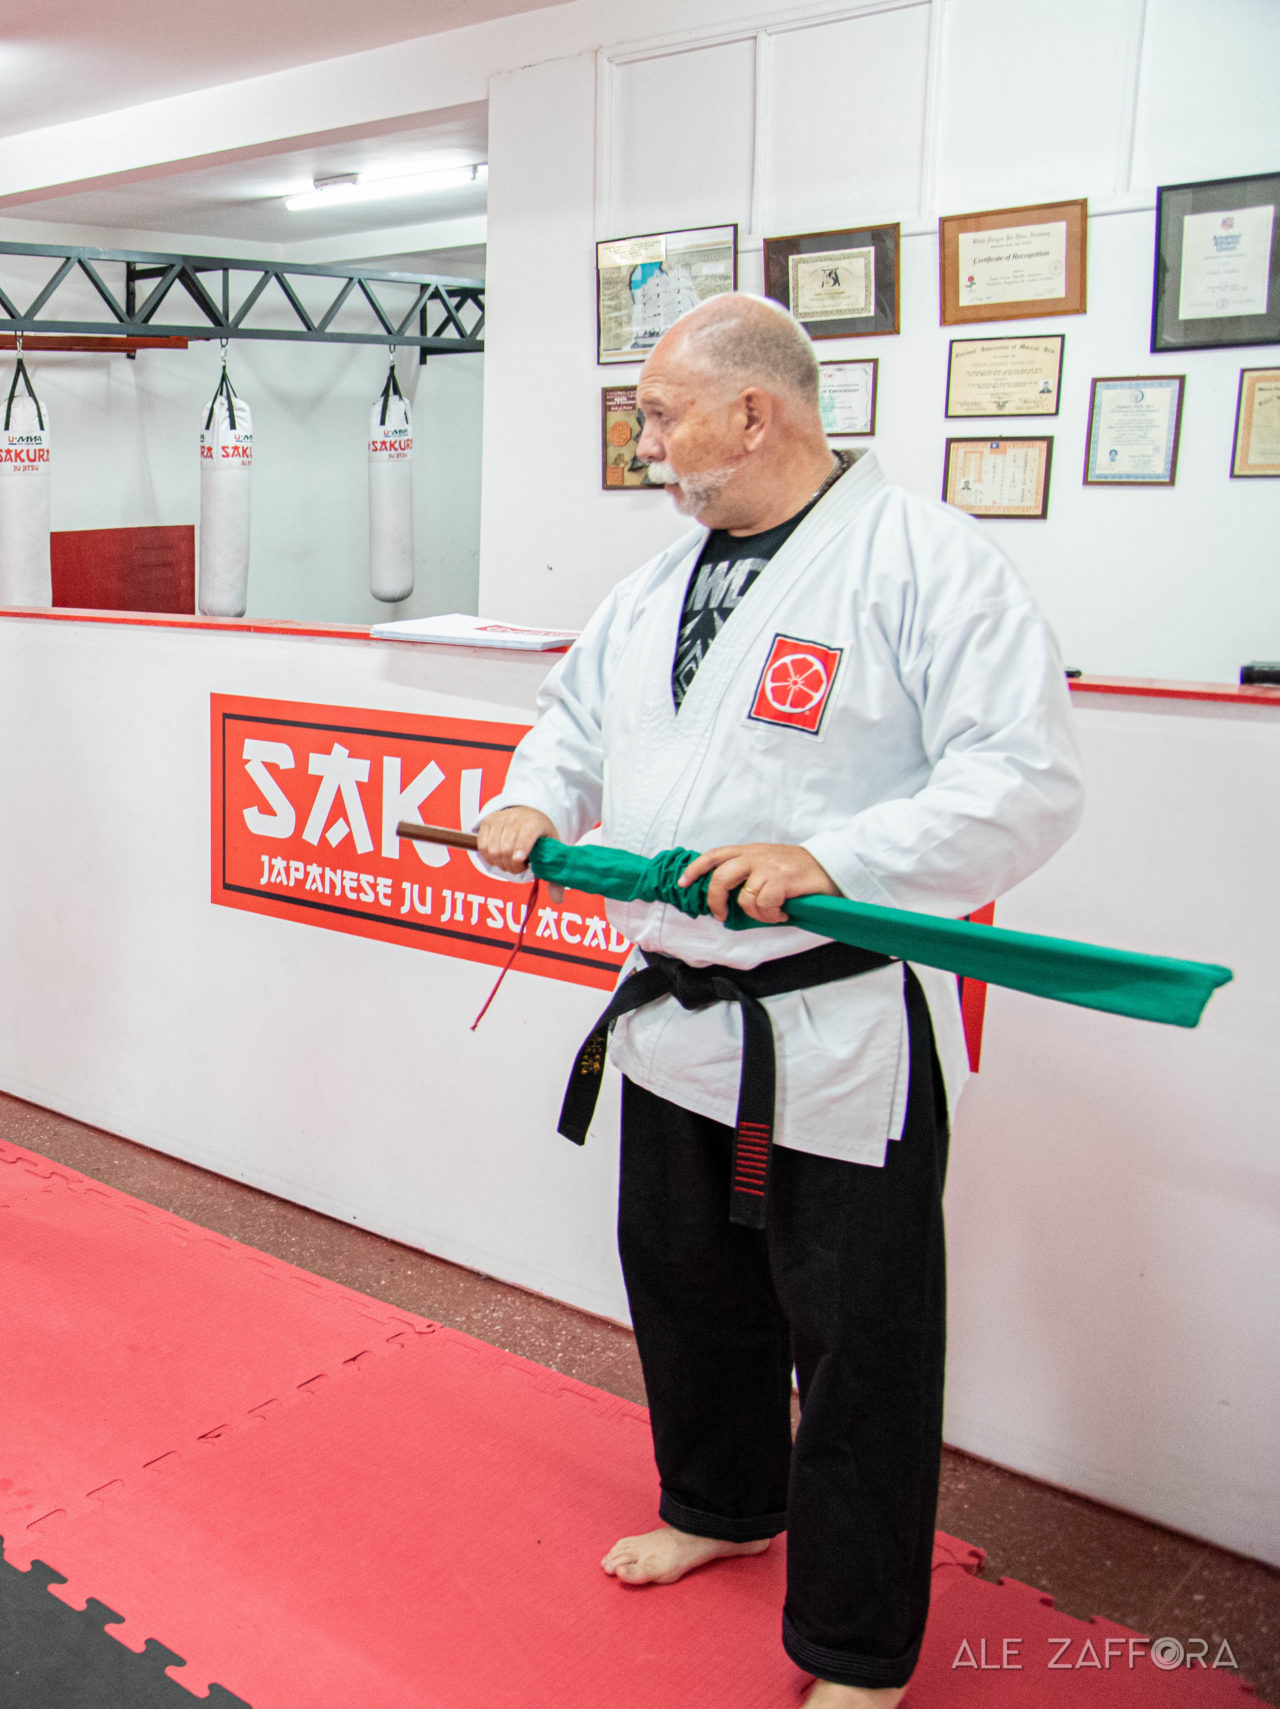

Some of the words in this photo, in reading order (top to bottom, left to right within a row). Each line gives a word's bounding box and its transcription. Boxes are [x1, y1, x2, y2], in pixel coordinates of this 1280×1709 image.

[973, 256, 1004, 265] Certificate
[1012, 250, 1050, 260] Recognition
[221, 444, 253, 459] SAK
[371, 438, 413, 452] SAKUR
[242, 738, 531, 883] SAKU
[260, 854, 393, 907] JAPANESE
[400, 881, 433, 915] JU
[440, 888, 528, 934] JITSU
[535, 906, 631, 953] ACAD
